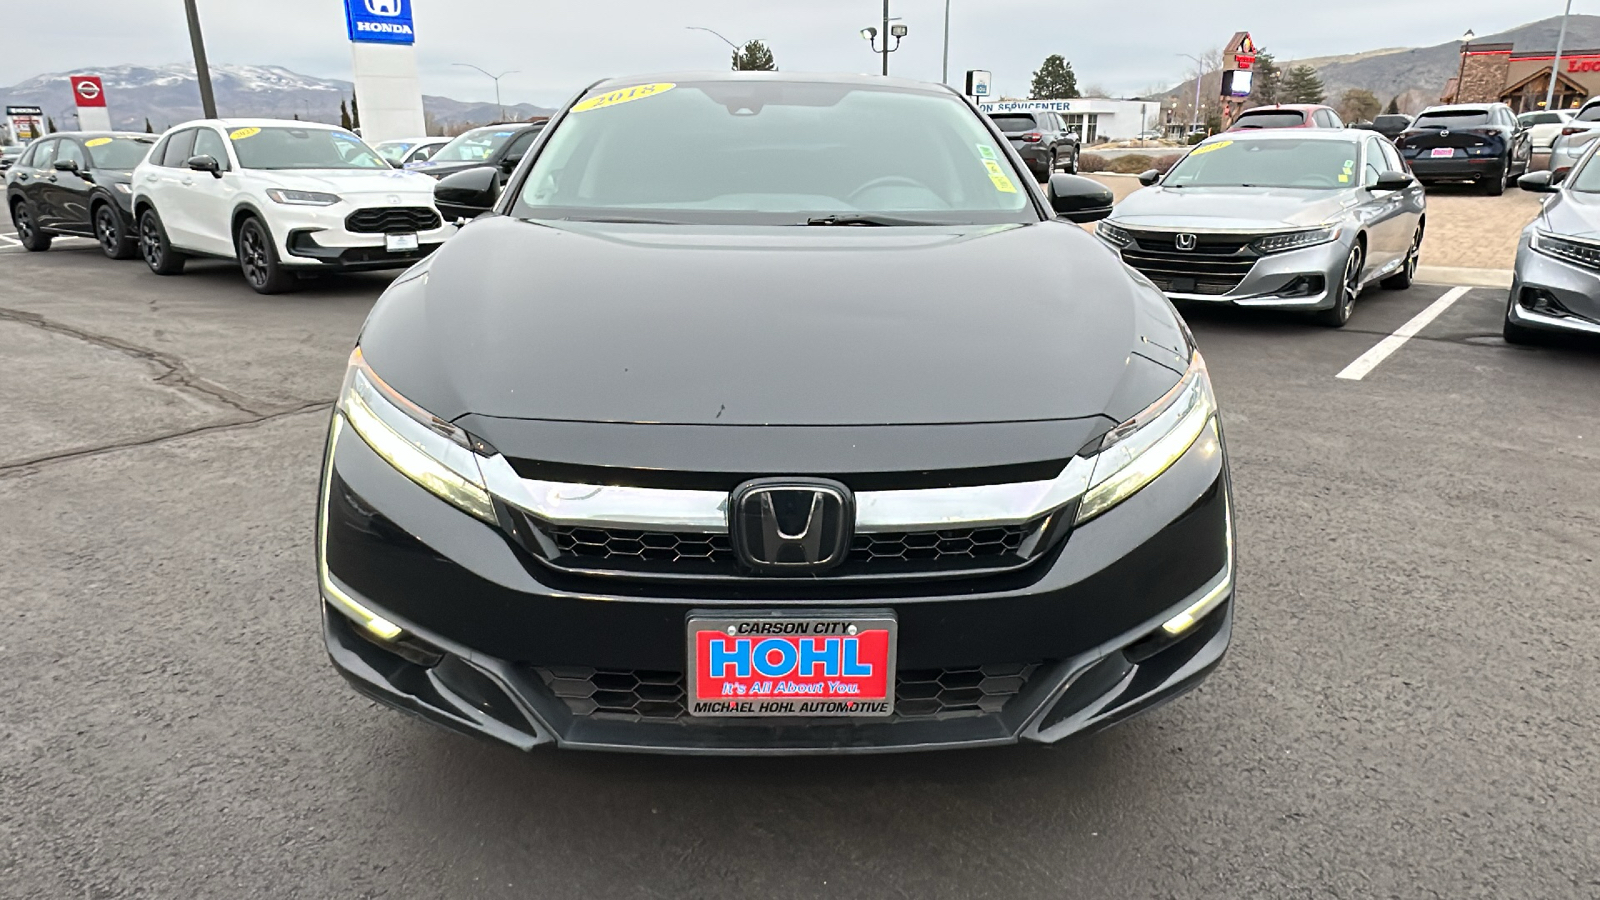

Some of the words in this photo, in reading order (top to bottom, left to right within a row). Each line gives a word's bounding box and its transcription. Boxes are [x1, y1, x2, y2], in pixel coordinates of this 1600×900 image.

[356, 21, 413, 34] HONDA
[593, 85, 656, 107] 2018
[737, 622, 806, 634] CARSON
[814, 622, 852, 634] CITY
[710, 638, 873, 678] HOHL
[721, 681, 747, 695] It's
[750, 681, 772, 694] All
[774, 681, 824, 693] About
[827, 681, 860, 693] You.
[694, 702, 755, 713] MICHAEL
[759, 702, 796, 713] HOHL
[799, 702, 888, 713] AUTOMOTIVE
